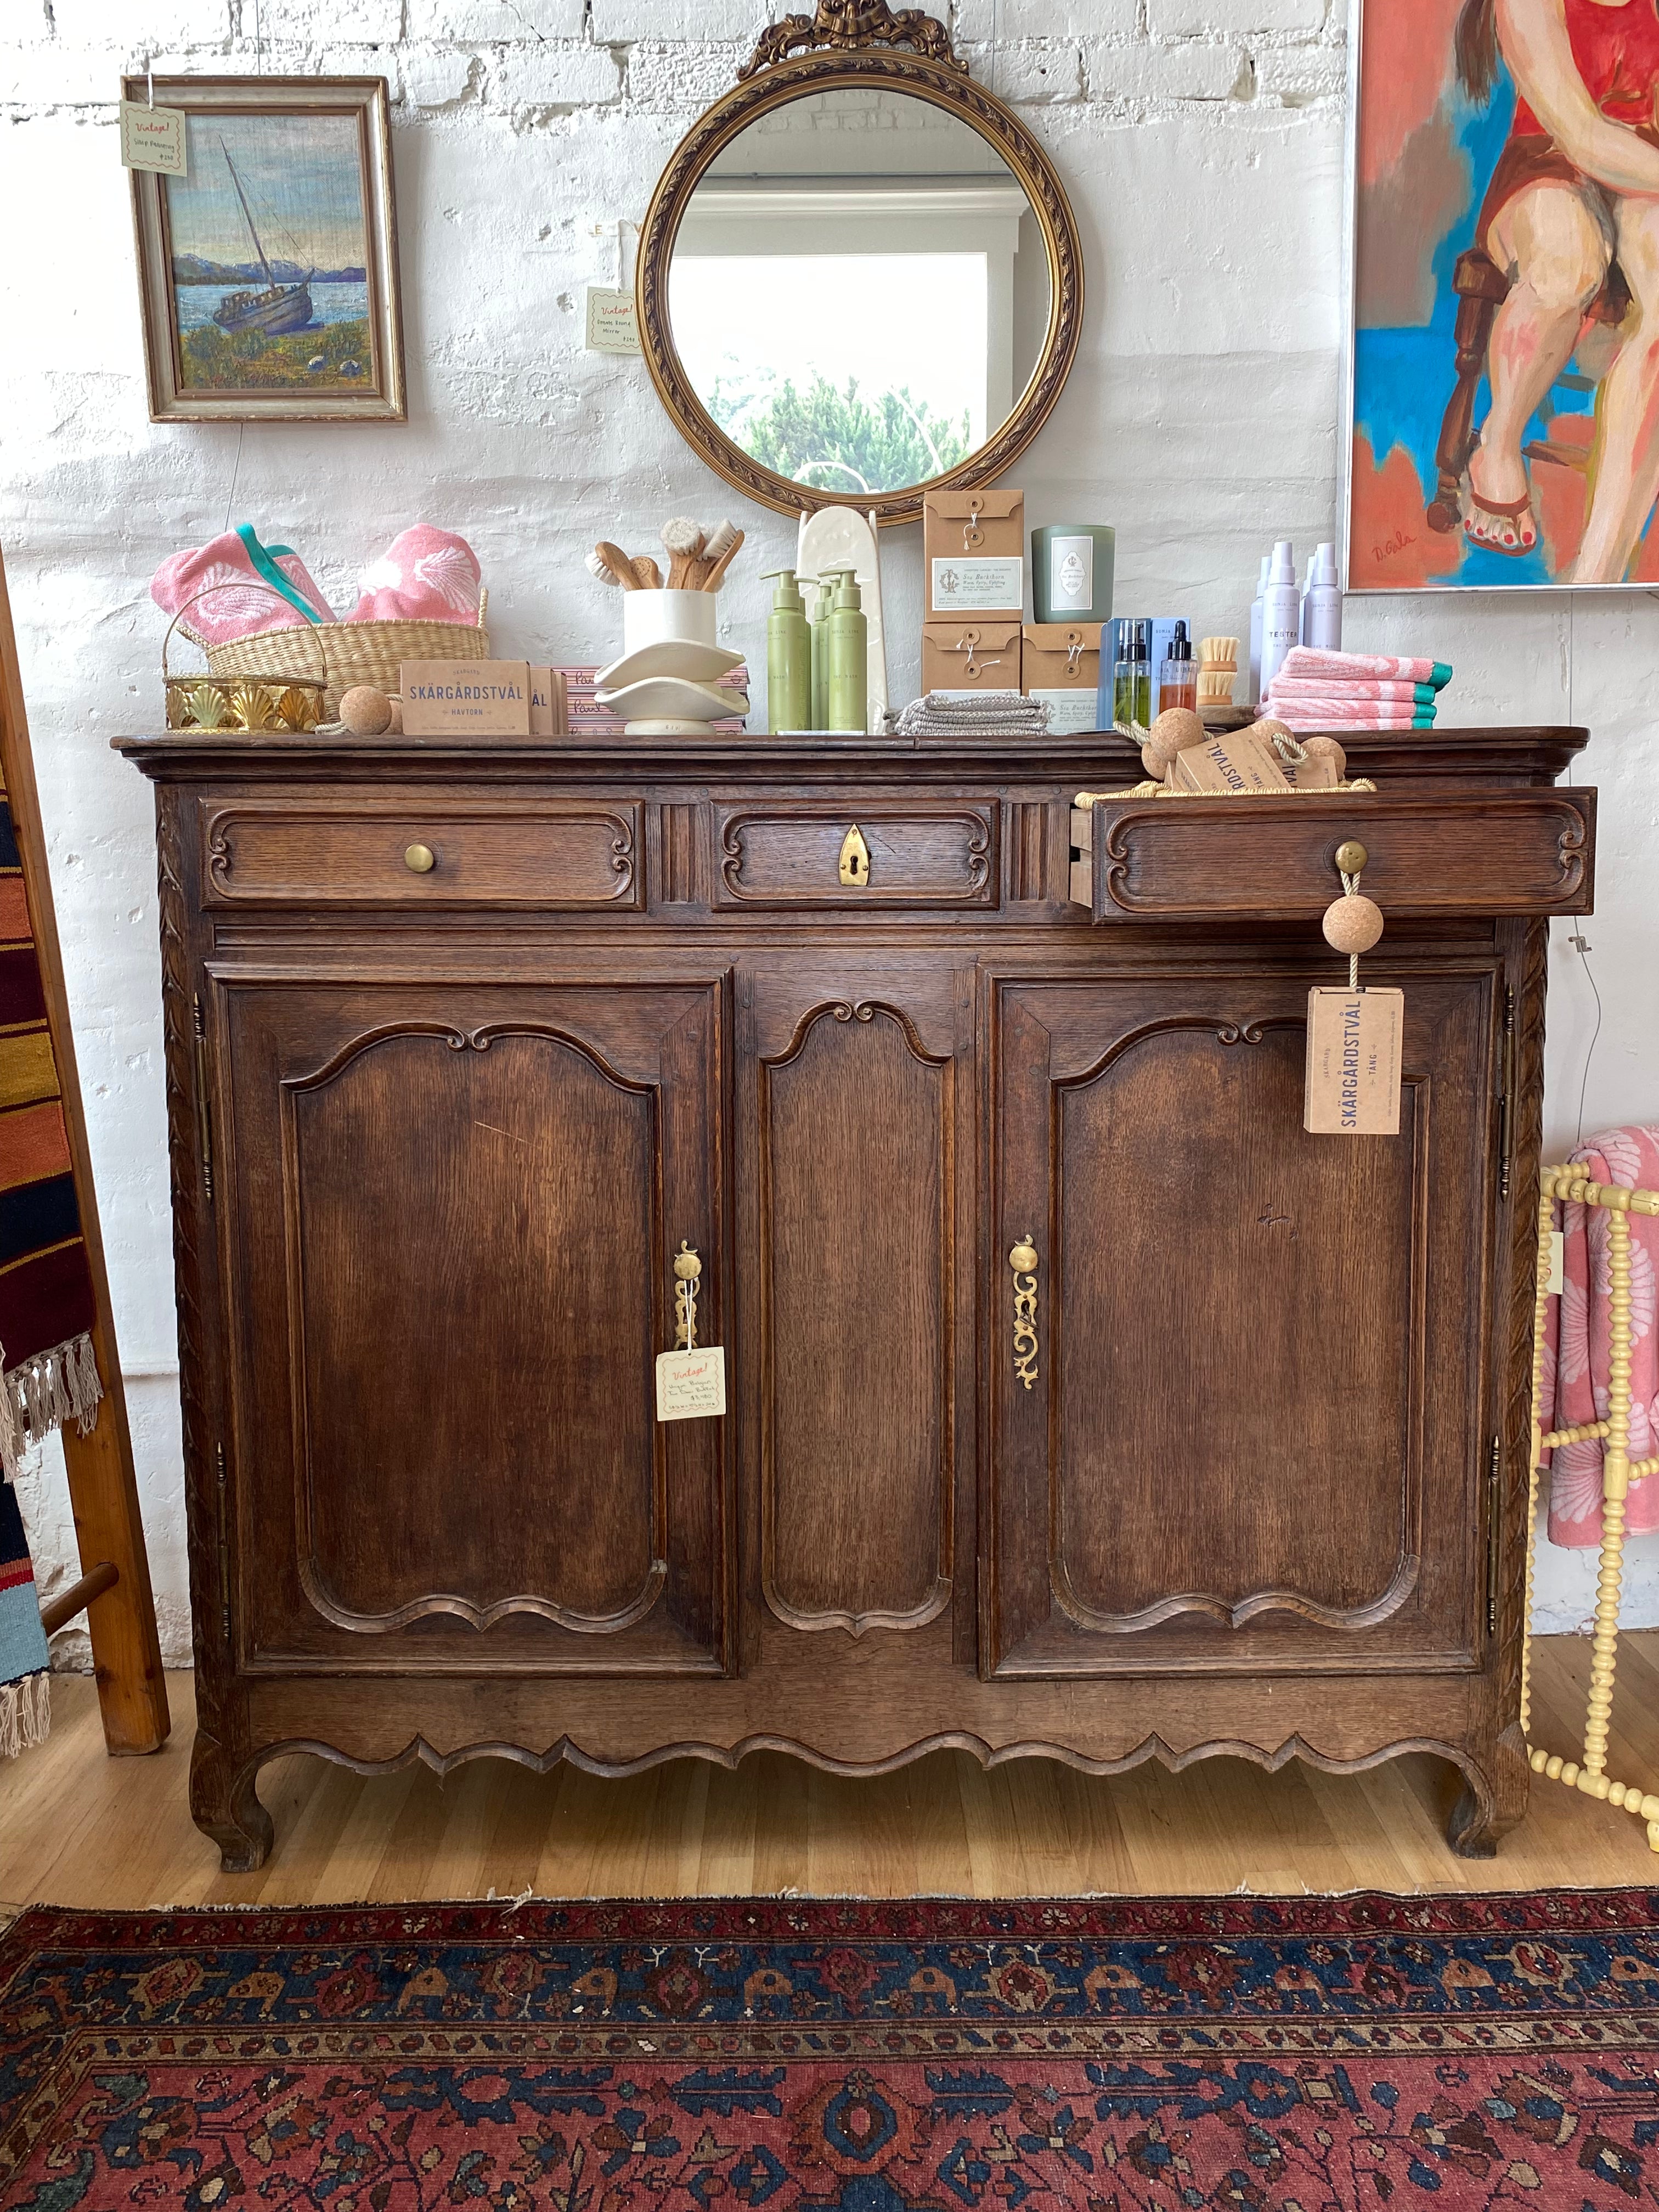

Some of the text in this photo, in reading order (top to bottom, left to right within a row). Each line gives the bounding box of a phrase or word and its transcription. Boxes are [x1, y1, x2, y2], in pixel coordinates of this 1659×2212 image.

[136, 122, 169, 134] Vintage!
[601, 304, 633, 315] Vintage!
[409, 681, 523, 700] SKÄRGÅRDSTVÅL
[1337, 1000, 1361, 1128] SKÄRGÅRDSTVÅL
[1366, 1053, 1377, 1075] TÅNG
[673, 1362, 708, 1380] Vintage!
